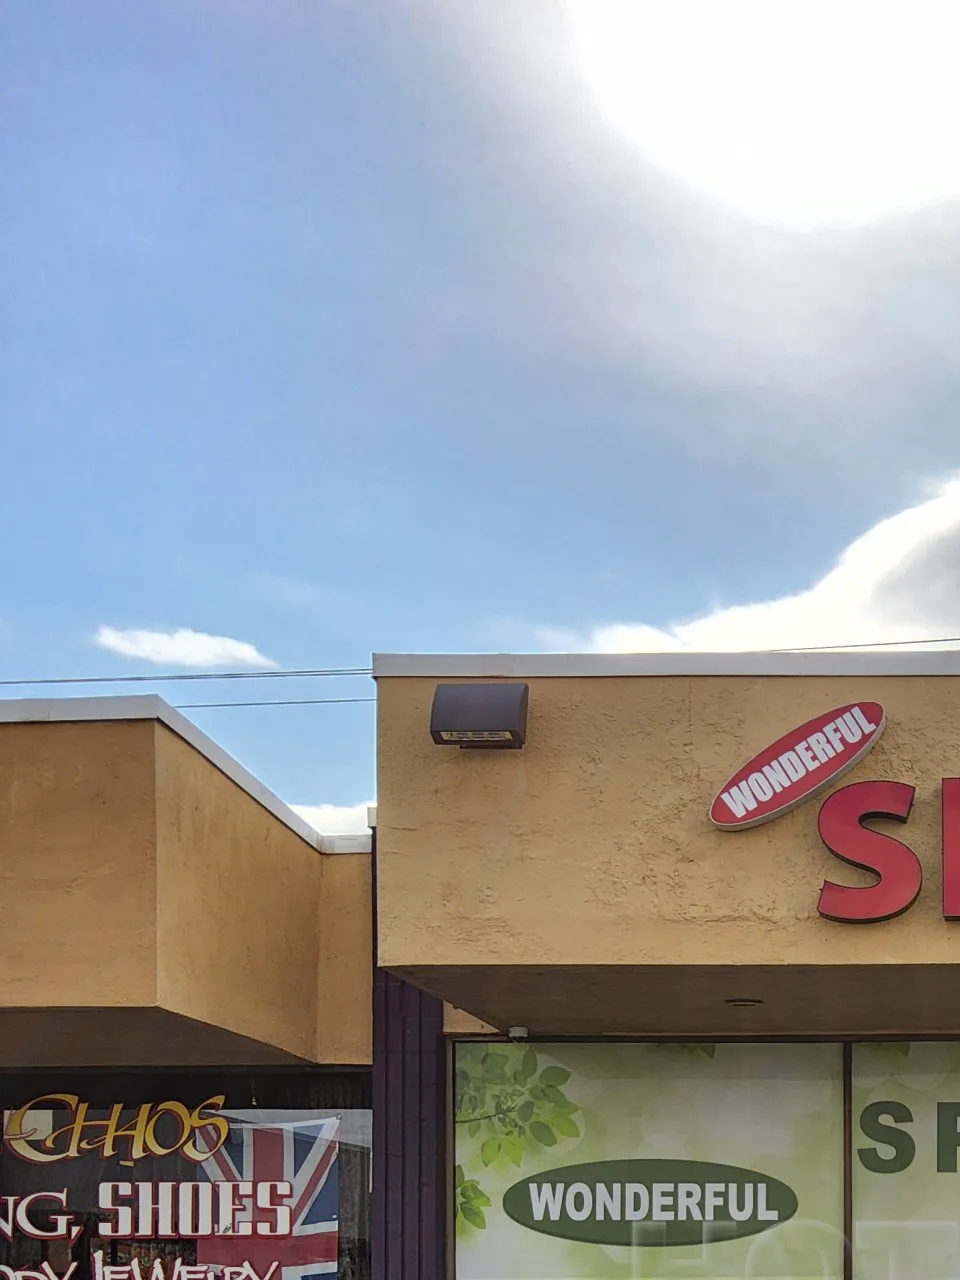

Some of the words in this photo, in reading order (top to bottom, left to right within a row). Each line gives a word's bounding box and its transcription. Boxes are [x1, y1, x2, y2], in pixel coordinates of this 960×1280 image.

[720, 706, 877, 819] WONDERFUL
[3, 1093, 229, 1163] CHAOS
[98, 1181, 293, 1239] SHOES
[528, 1182, 779, 1221] WONDERFUL
